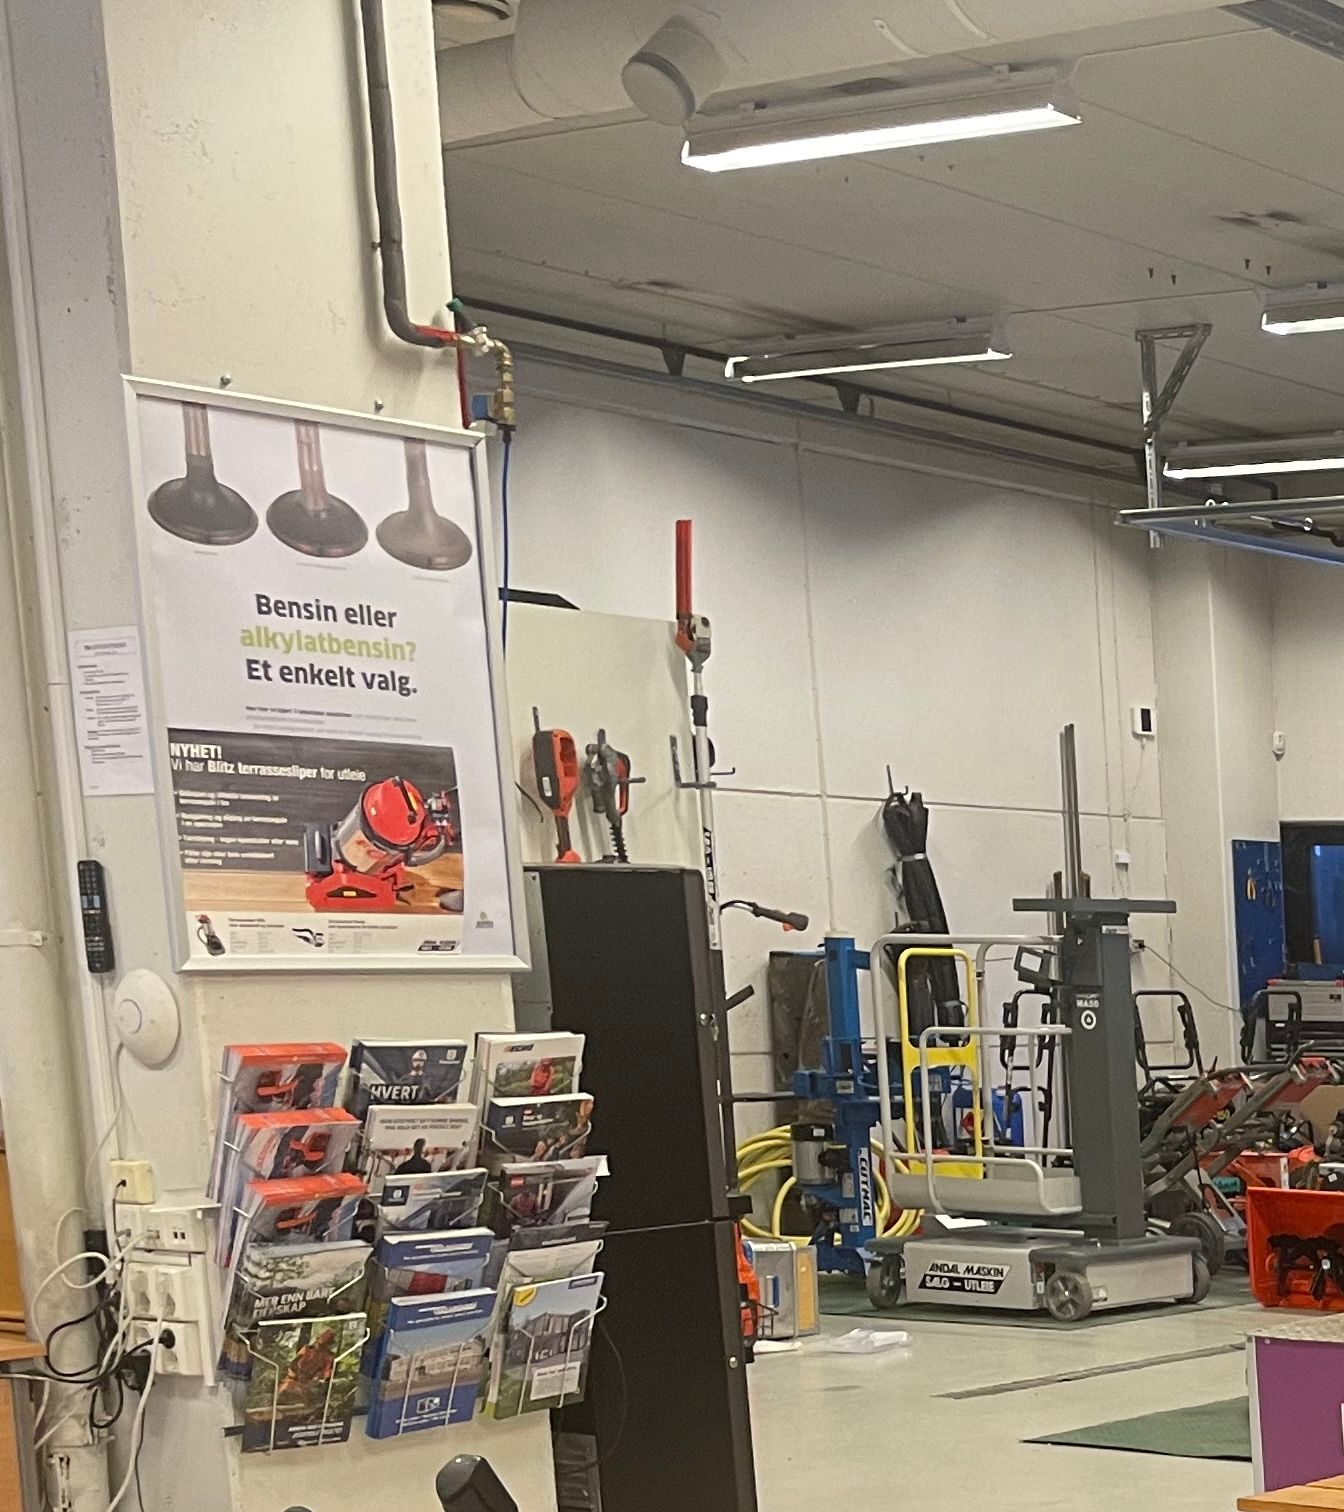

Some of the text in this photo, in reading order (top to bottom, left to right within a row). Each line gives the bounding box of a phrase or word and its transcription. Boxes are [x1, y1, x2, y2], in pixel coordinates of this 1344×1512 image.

[255, 593, 398, 628] Bensin eller
[239, 625, 417, 662] alkylatbensin?
[246, 657, 418, 697] Et enkelt valg.
[170, 742, 223, 760] NYHET!
[186, 760, 204, 773] har
[370, 1084, 419, 1100] HVERT
